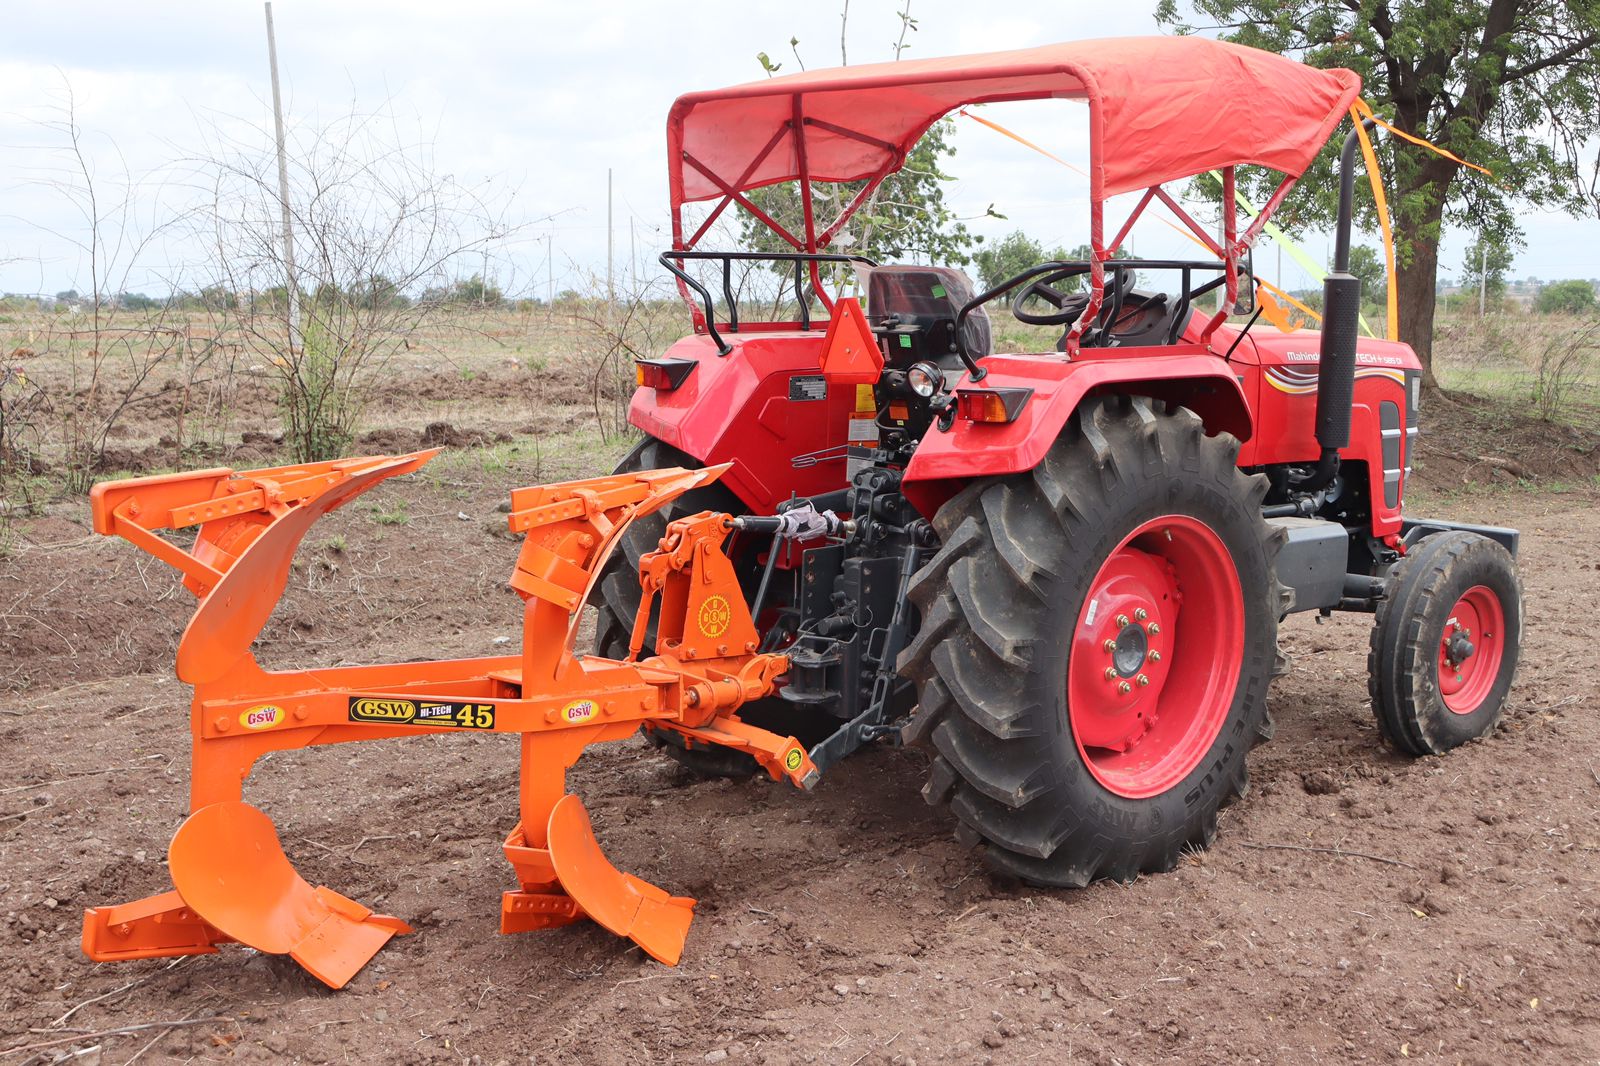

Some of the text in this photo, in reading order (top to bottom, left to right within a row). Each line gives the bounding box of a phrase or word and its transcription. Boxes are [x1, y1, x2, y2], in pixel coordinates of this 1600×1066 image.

[1287, 351, 1320, 361] Mahind
[247, 710, 276, 725] GSW
[360, 701, 409, 717] GSW
[420, 704, 452, 718] HI-TECH
[456, 704, 493, 728] 45
[568, 704, 592, 719] GSW
[1184, 742, 1234, 810] PLUS
